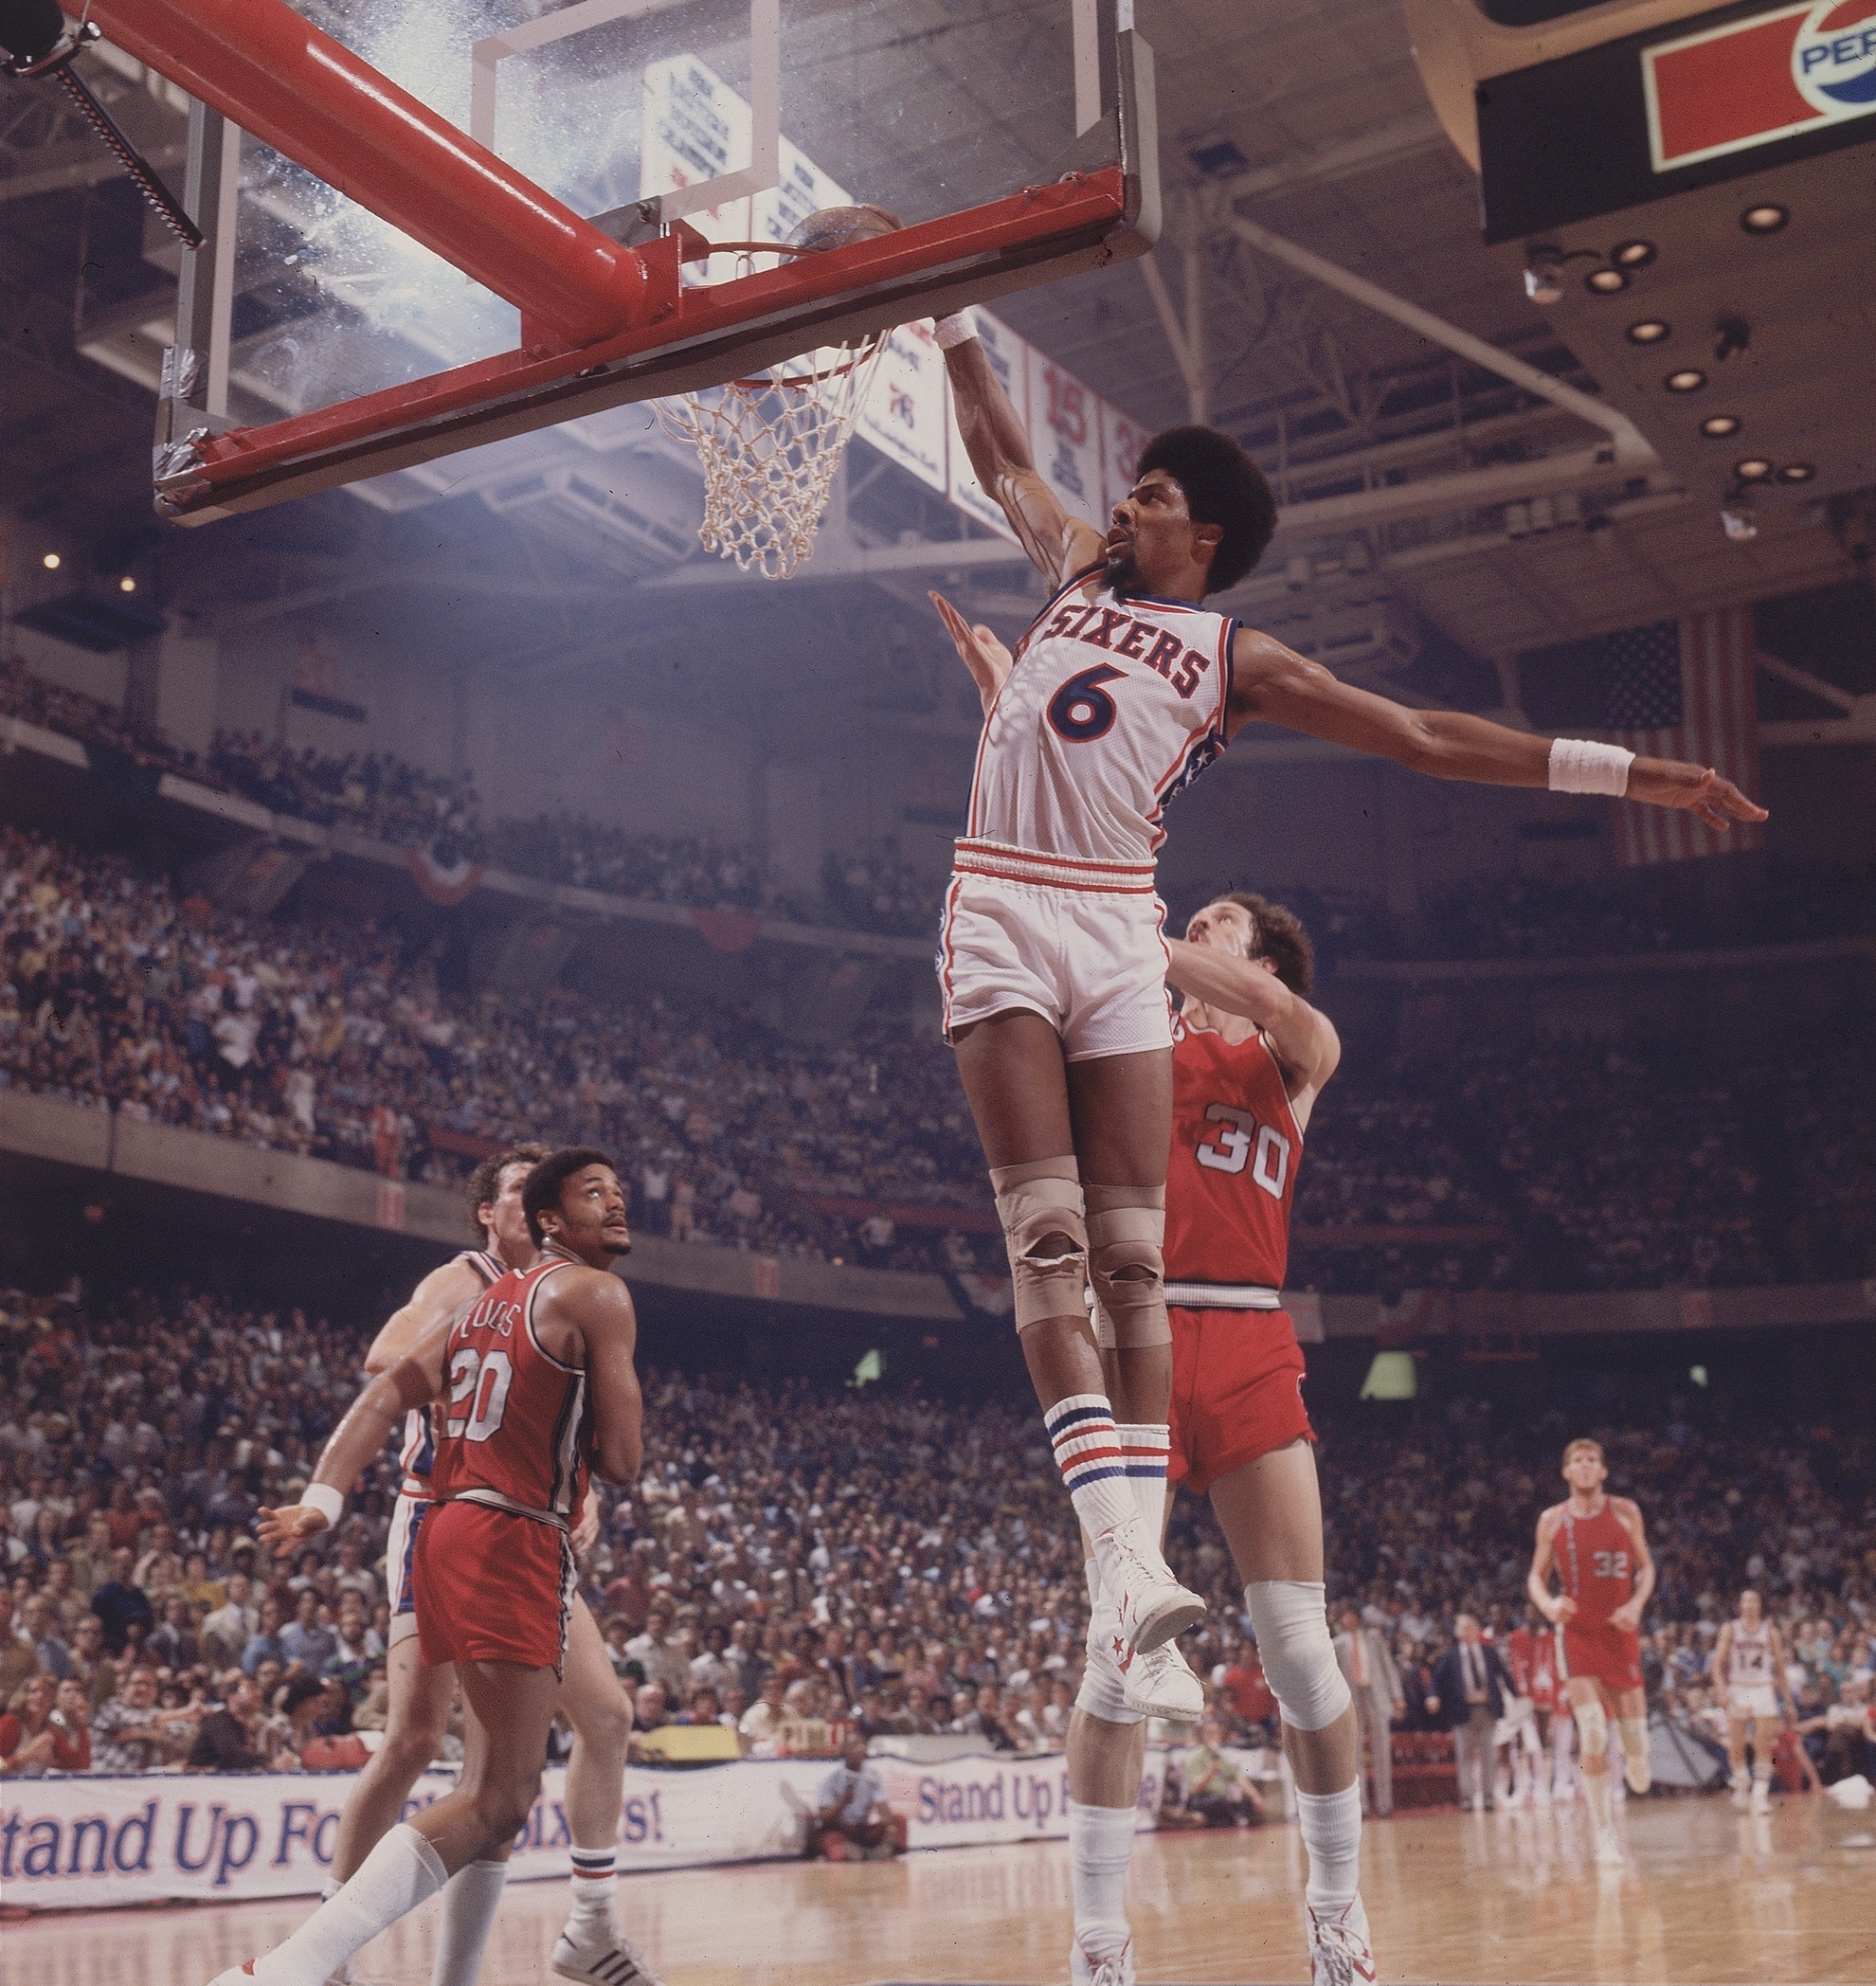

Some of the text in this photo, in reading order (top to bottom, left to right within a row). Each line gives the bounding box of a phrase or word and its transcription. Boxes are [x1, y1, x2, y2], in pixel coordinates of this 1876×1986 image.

[1044, 369, 1087, 447] 15
[1043, 604, 1211, 700] SIXERS
[1046, 662, 1129, 744] 6
[1196, 1102, 1290, 1201] 30
[446, 1347, 513, 1442] 20
[1592, 1550, 1629, 1580] 32
[1738, 1652, 1763, 1670] 14
[918, 1771, 1004, 1825] Stand
[1014, 1774, 1053, 1830] Up
[0, 1799, 159, 1879] tand
[175, 1804, 260, 1887] Up
[273, 1803, 342, 1867] Fo
